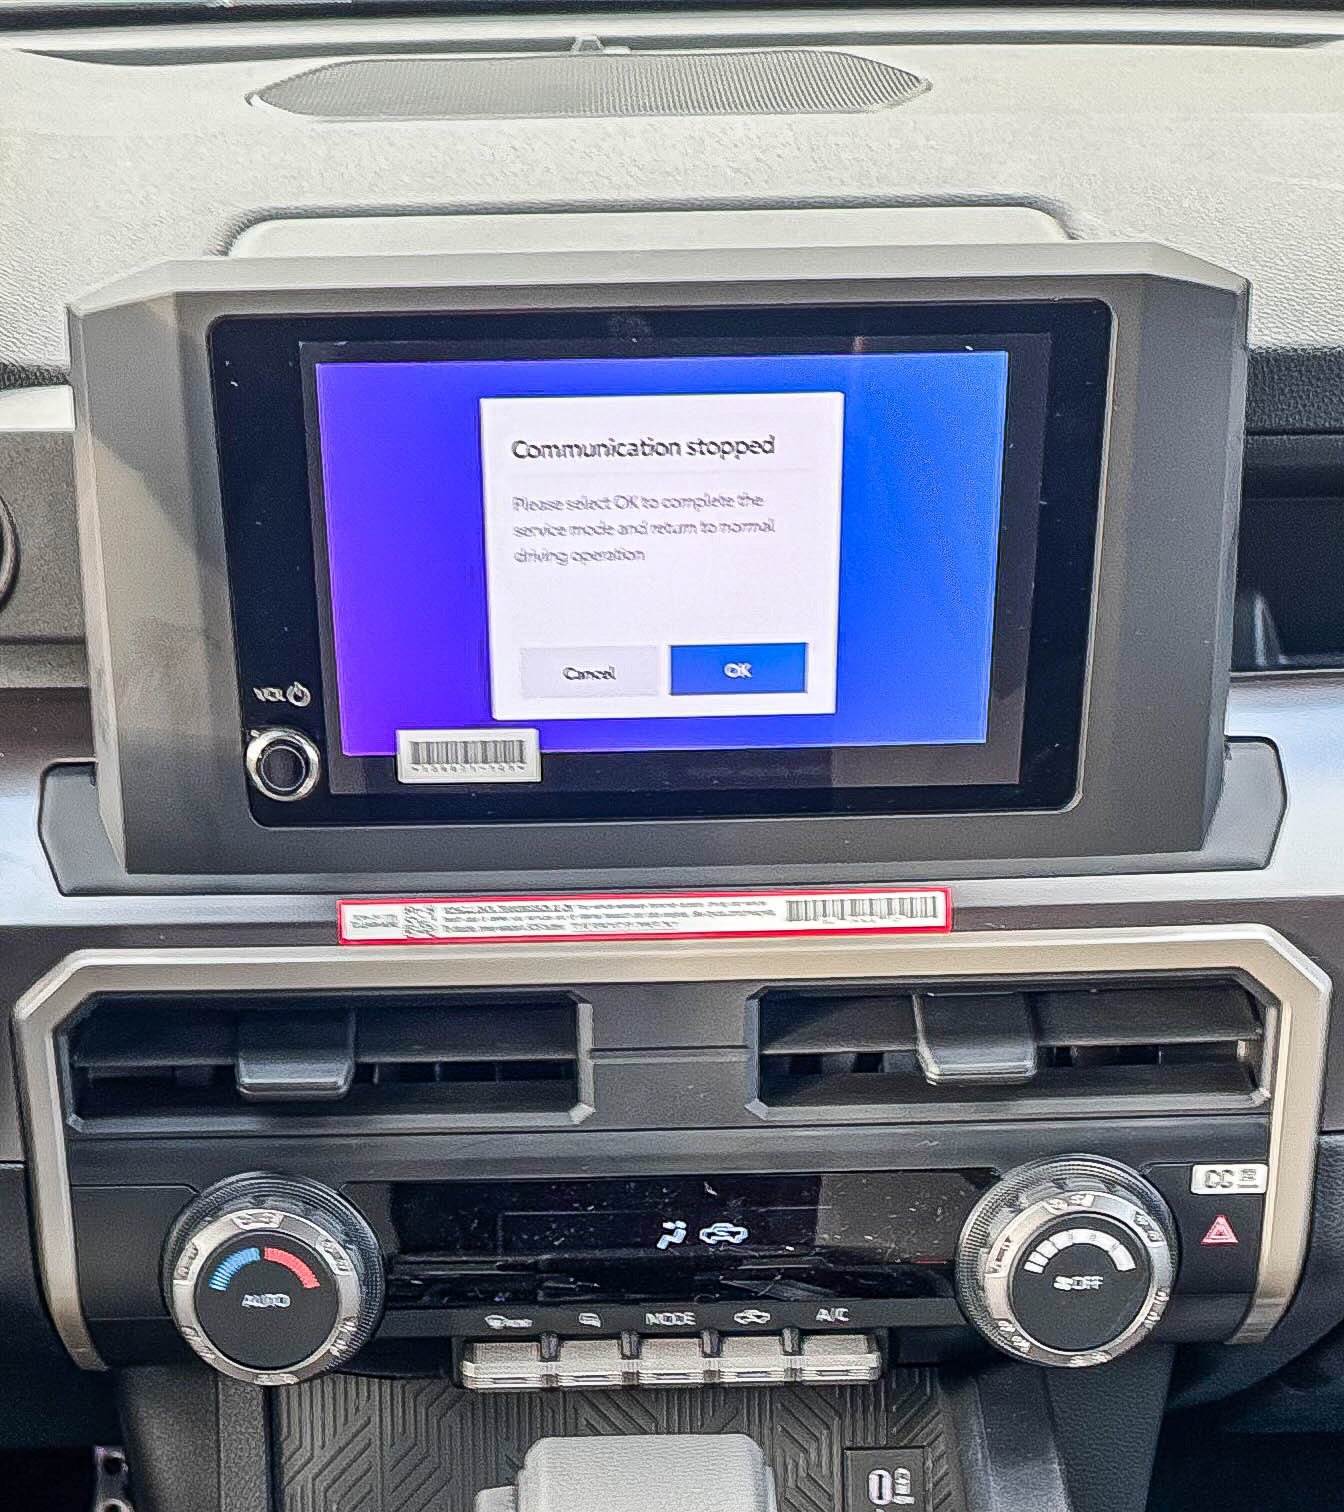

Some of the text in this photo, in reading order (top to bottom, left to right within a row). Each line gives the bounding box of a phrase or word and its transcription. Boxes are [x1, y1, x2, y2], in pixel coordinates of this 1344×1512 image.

[511, 434, 777, 461] Communication stopped
[512, 493, 765, 512] Please select OK to complete the
[513, 518, 777, 538] service mode and return to normal
[514, 548, 647, 566] driving operation
[562, 664, 617, 683] Cancel
[724, 661, 752, 680] OK
[645, 1312, 697, 1326] MODE
